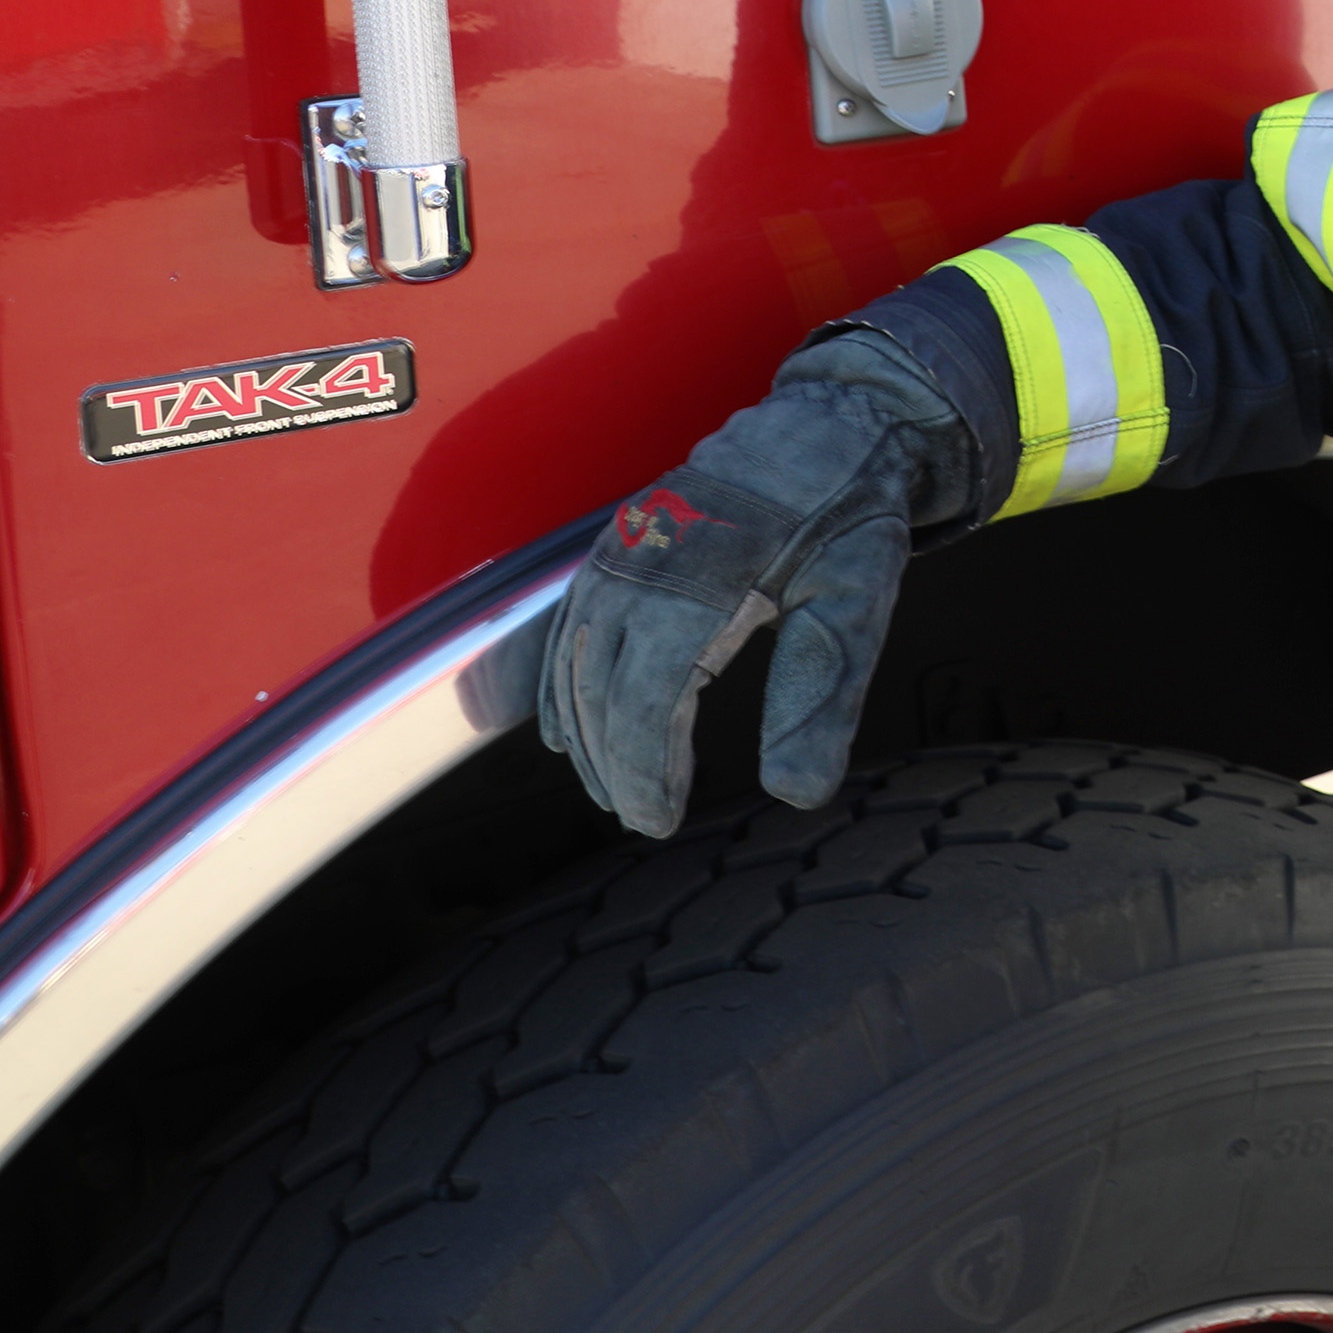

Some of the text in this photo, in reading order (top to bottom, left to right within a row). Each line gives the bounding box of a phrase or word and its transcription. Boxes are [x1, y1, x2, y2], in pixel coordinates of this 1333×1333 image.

[106, 350, 397, 437] TAK-4
[111, 399, 398, 457] INDEPENDENT FRONT SUSPENSION
